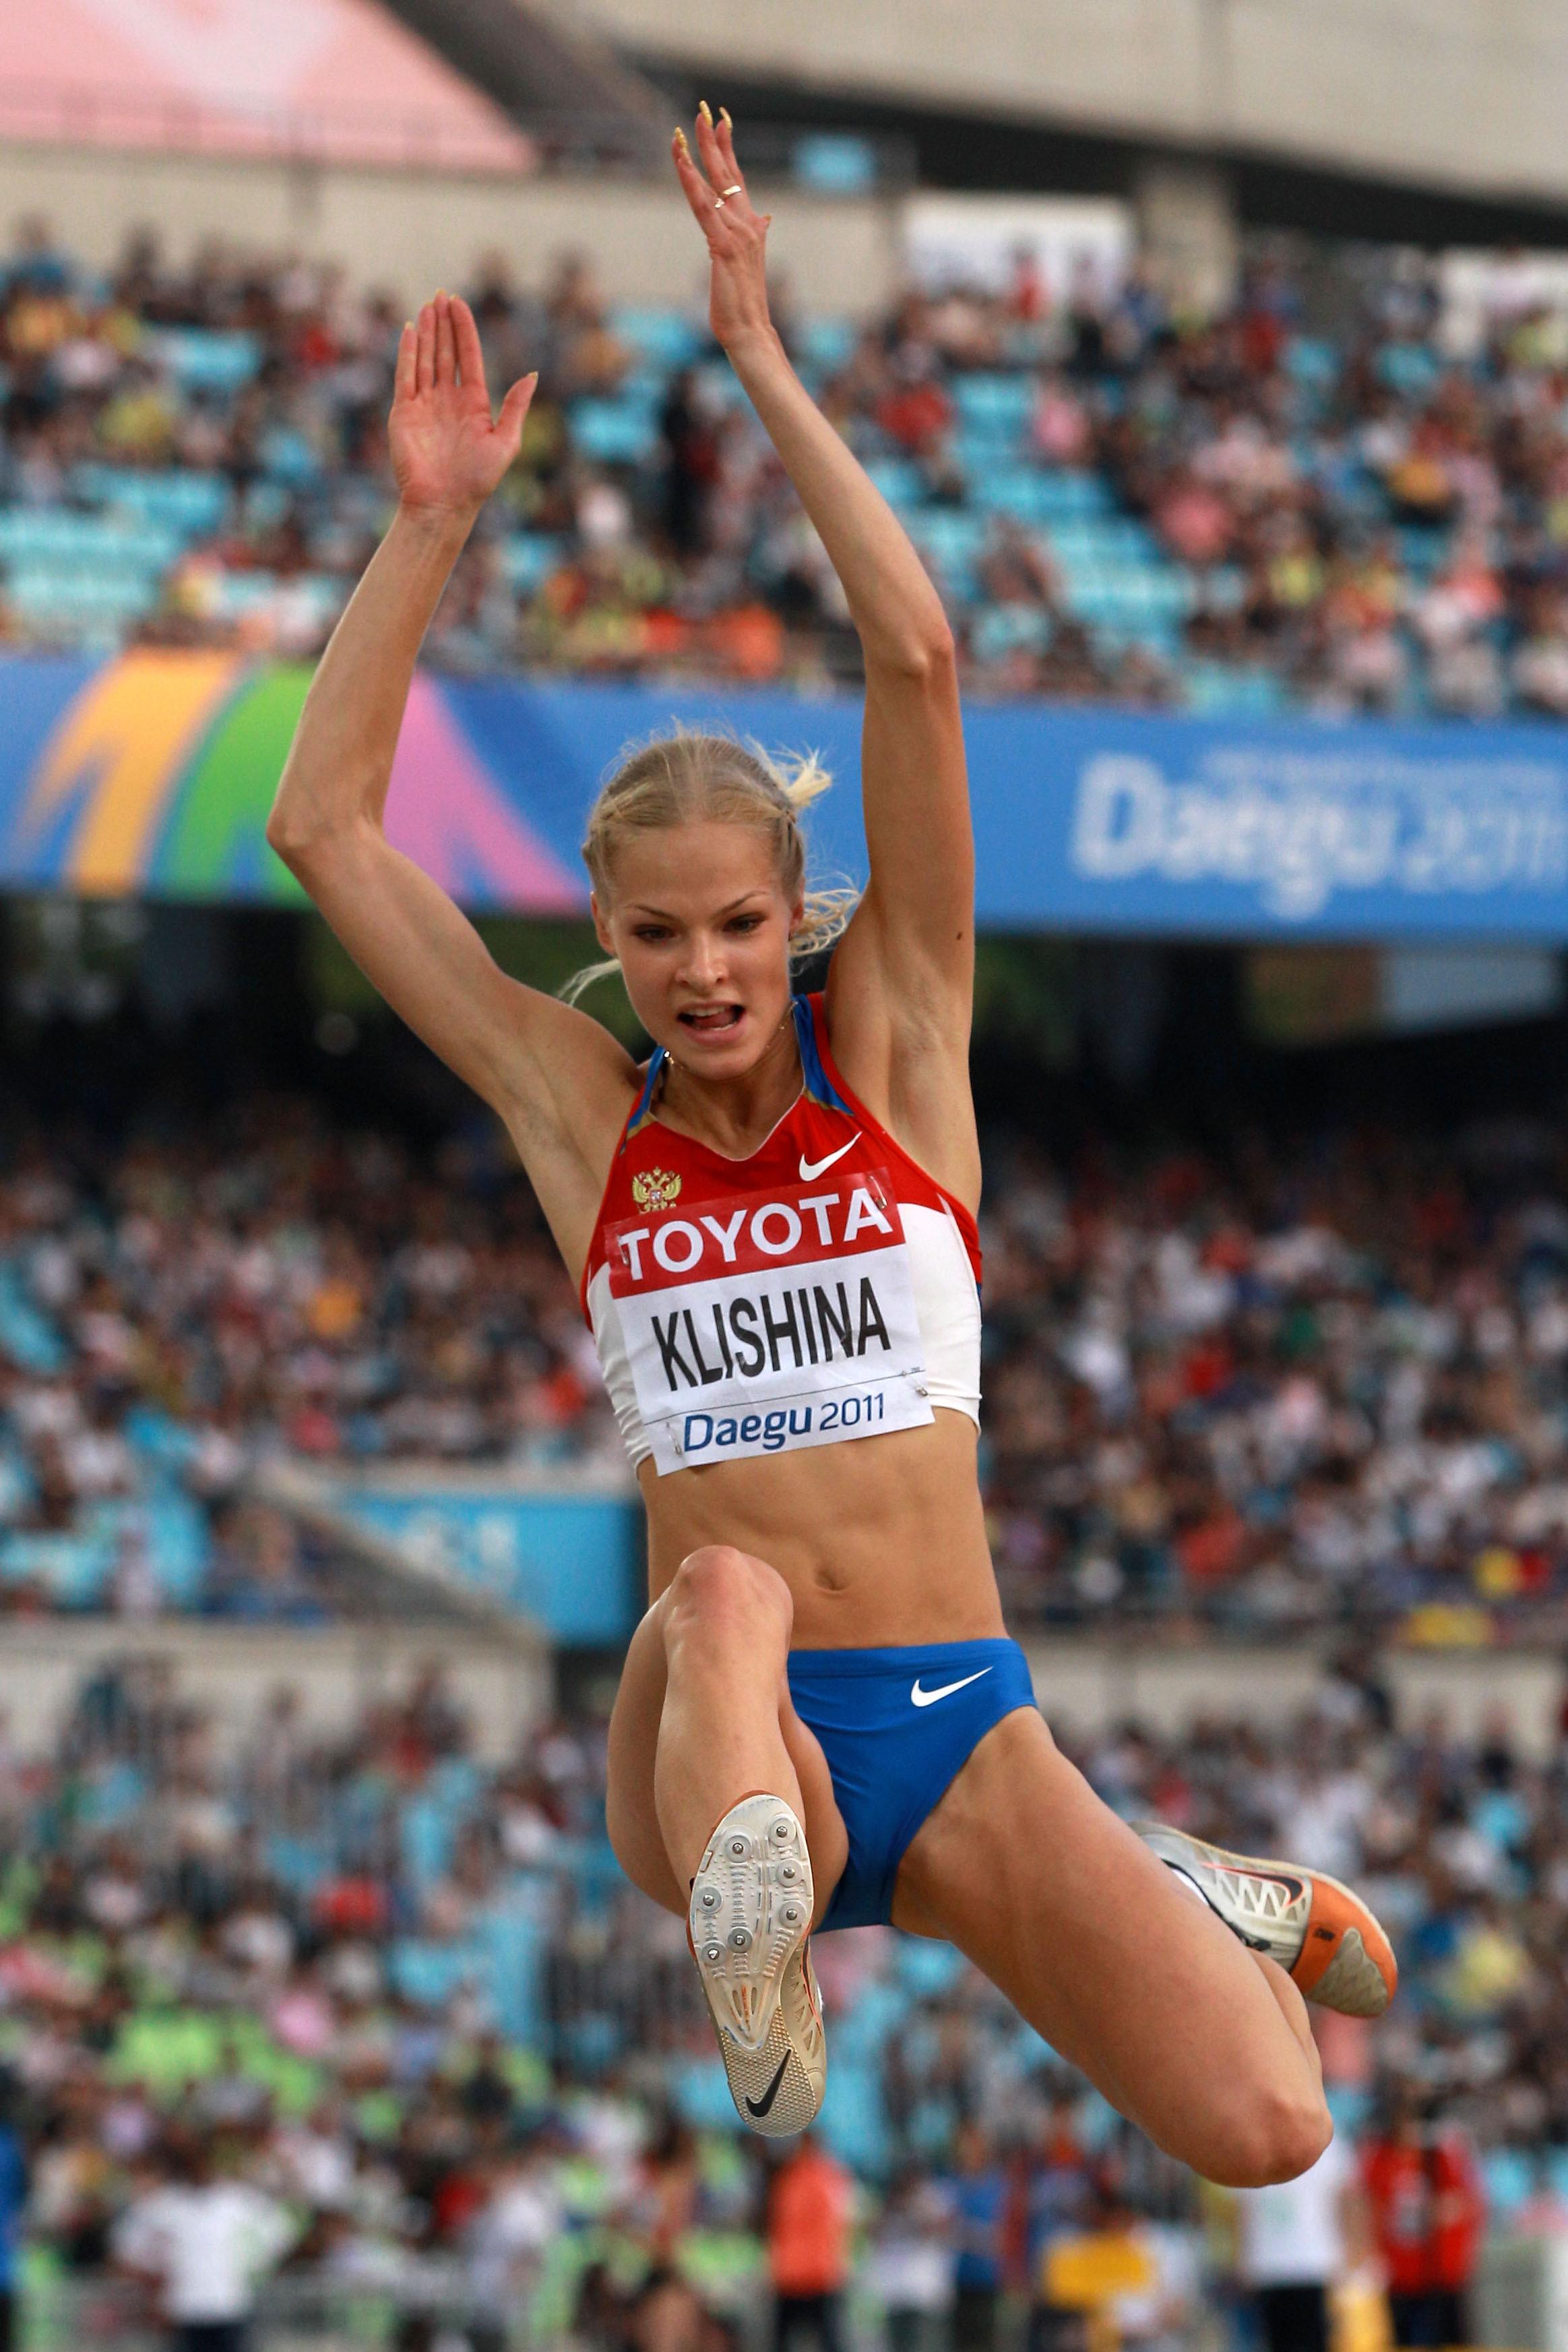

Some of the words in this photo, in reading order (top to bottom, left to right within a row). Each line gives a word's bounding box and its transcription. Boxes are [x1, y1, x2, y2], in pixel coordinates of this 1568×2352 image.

[619, 1187, 893, 1280] TOYOTA
[652, 1277, 891, 1392] KLISHINA
[684, 1406, 812, 1450] Daegu
[819, 1392, 885, 1431] 2011
